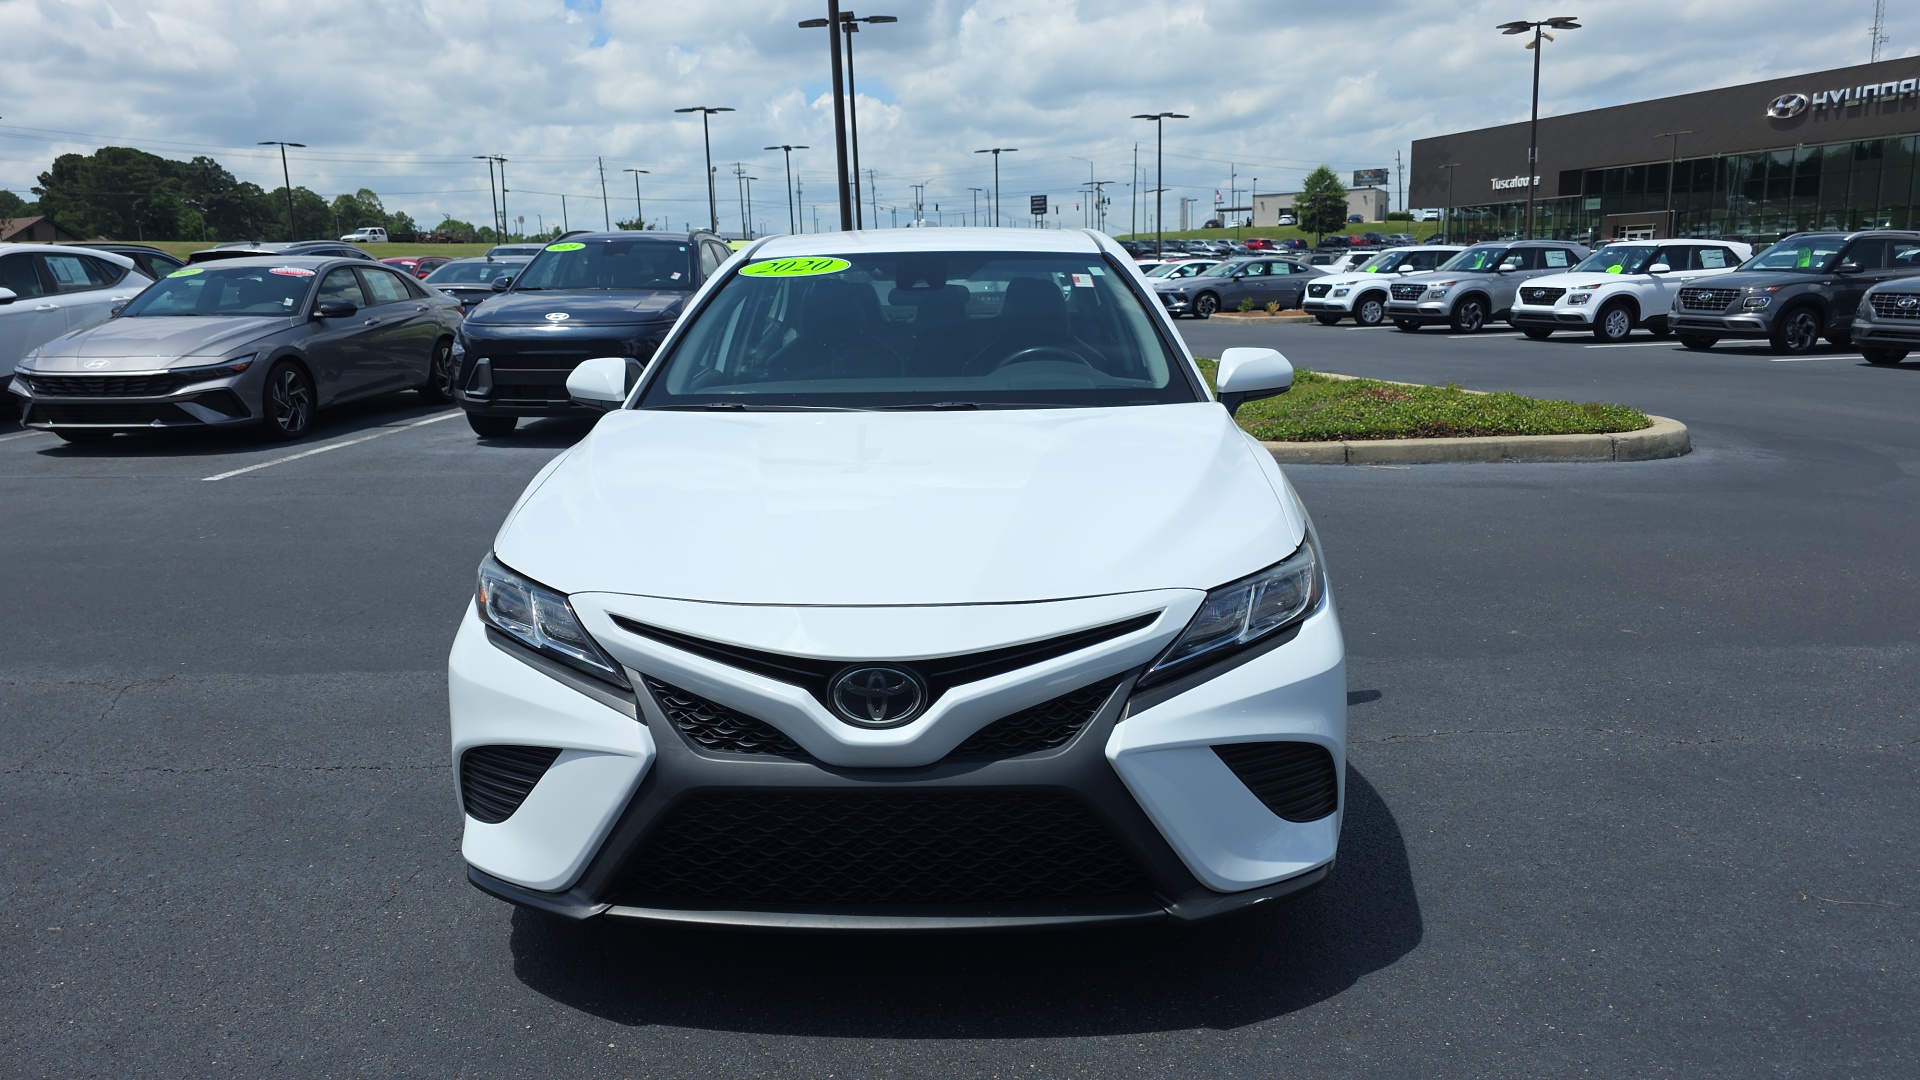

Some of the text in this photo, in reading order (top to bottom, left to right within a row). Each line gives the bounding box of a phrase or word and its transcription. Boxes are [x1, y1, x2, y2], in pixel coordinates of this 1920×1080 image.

[1812, 78, 1920, 110] HYUNDA
[1490, 175, 1540, 190] Tuscalooa
[754, 259, 834, 274] 2020
